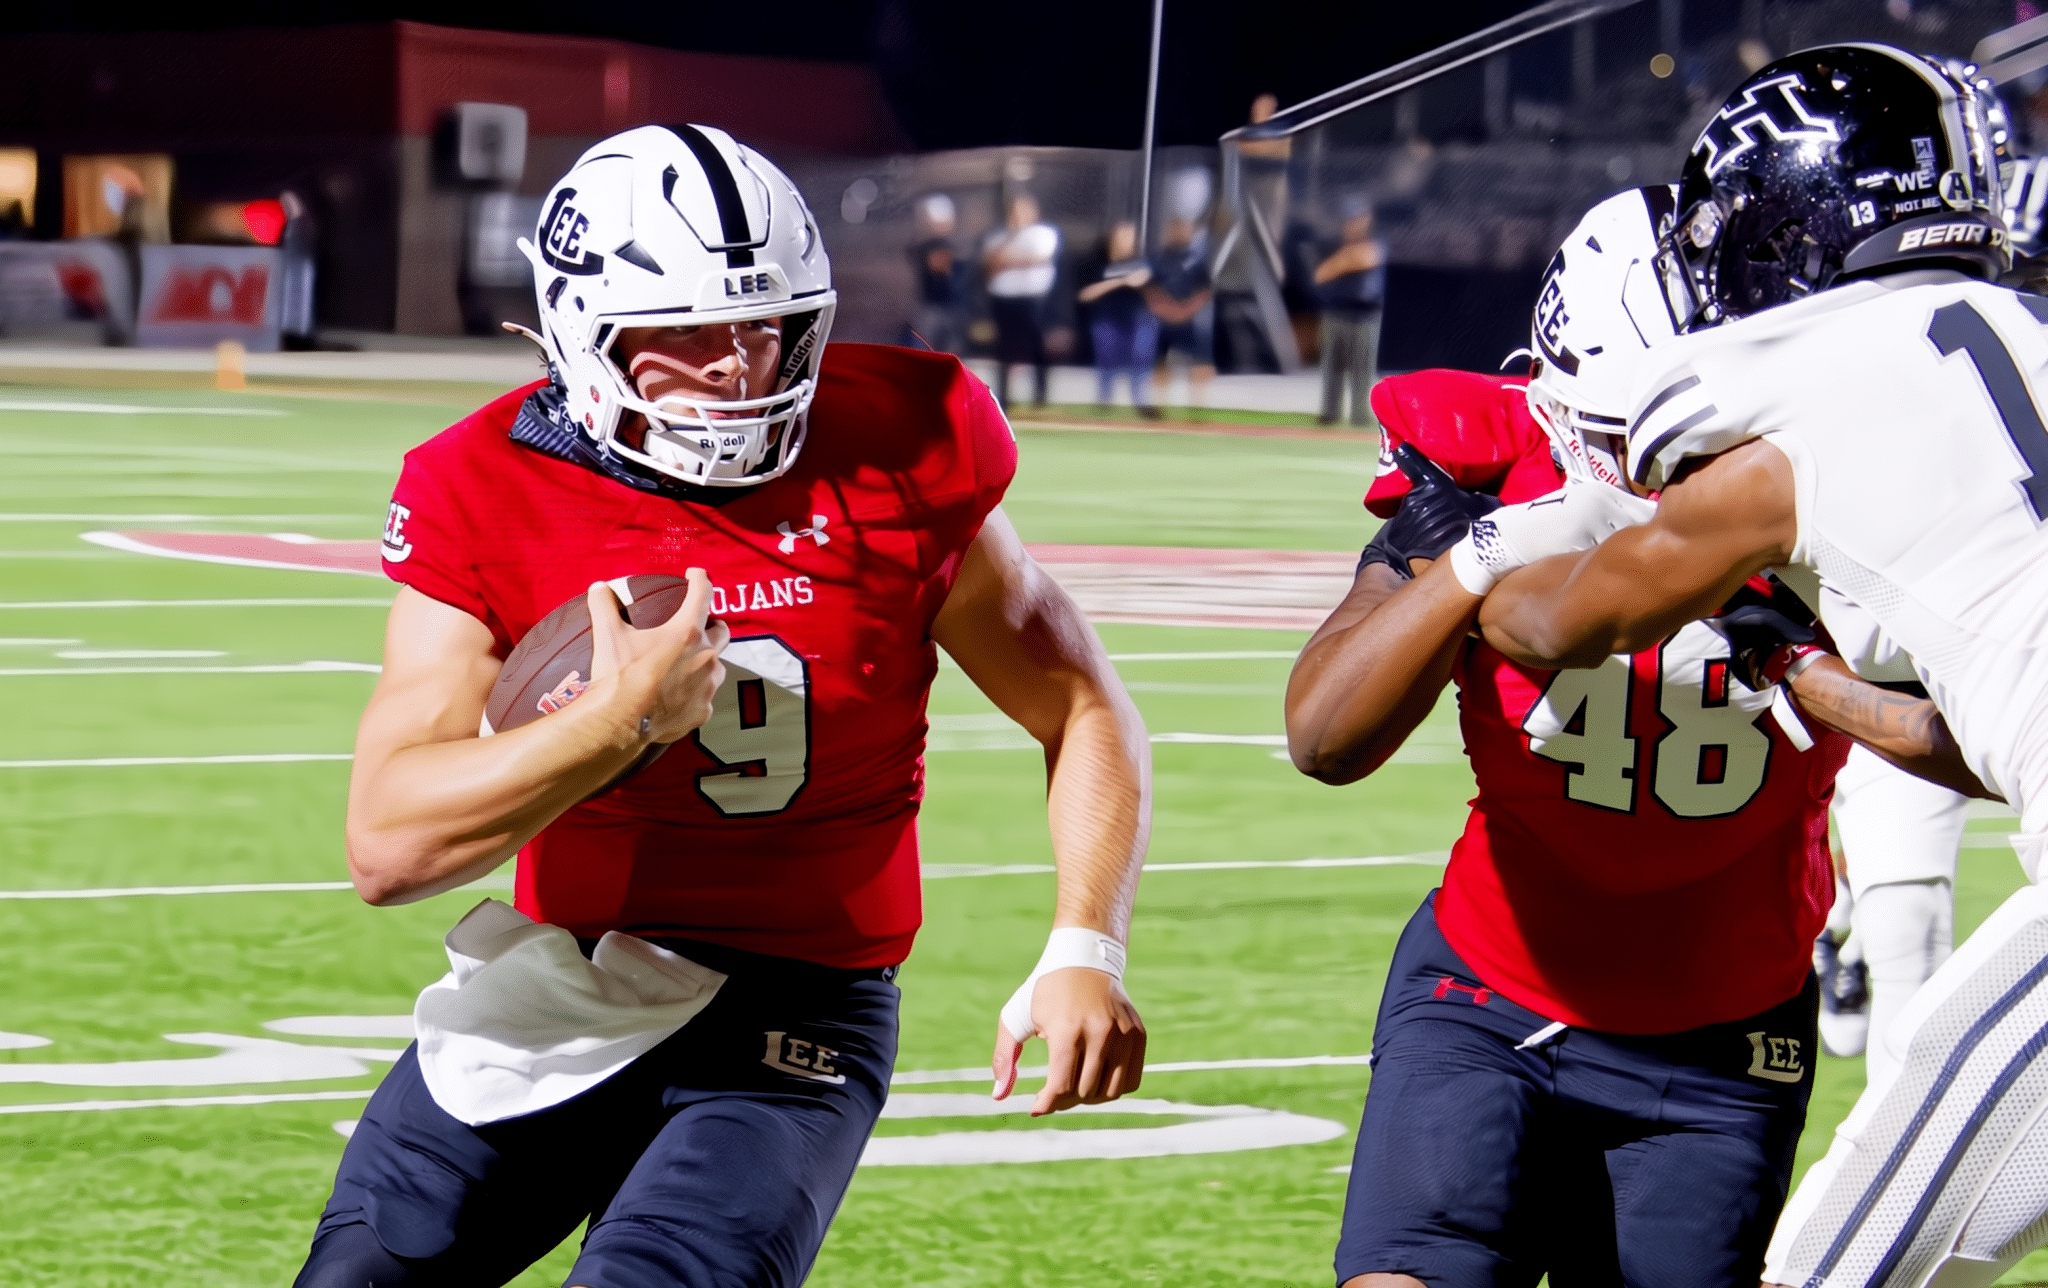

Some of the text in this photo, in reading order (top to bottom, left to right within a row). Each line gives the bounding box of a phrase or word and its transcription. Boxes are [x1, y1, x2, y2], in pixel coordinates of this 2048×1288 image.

[1893, 171, 1933, 193] WE
[1849, 200, 1877, 228] 13
[1895, 199, 1920, 214] NOT
[538, 187, 605, 276] LEE
[1897, 223, 1987, 252] BEAR
[724, 272, 769, 296] LEE
[1534, 247, 1581, 377] LEE
[700, 434, 746, 449] Ridell
[1568, 439, 1619, 486] Ridell
[709, 576, 814, 615] OJANS
[693, 634, 811, 820] 9
[1521, 618, 1774, 820] 48
[761, 1031, 847, 1085] LEE
[1745, 1031, 1805, 1083] LEE
